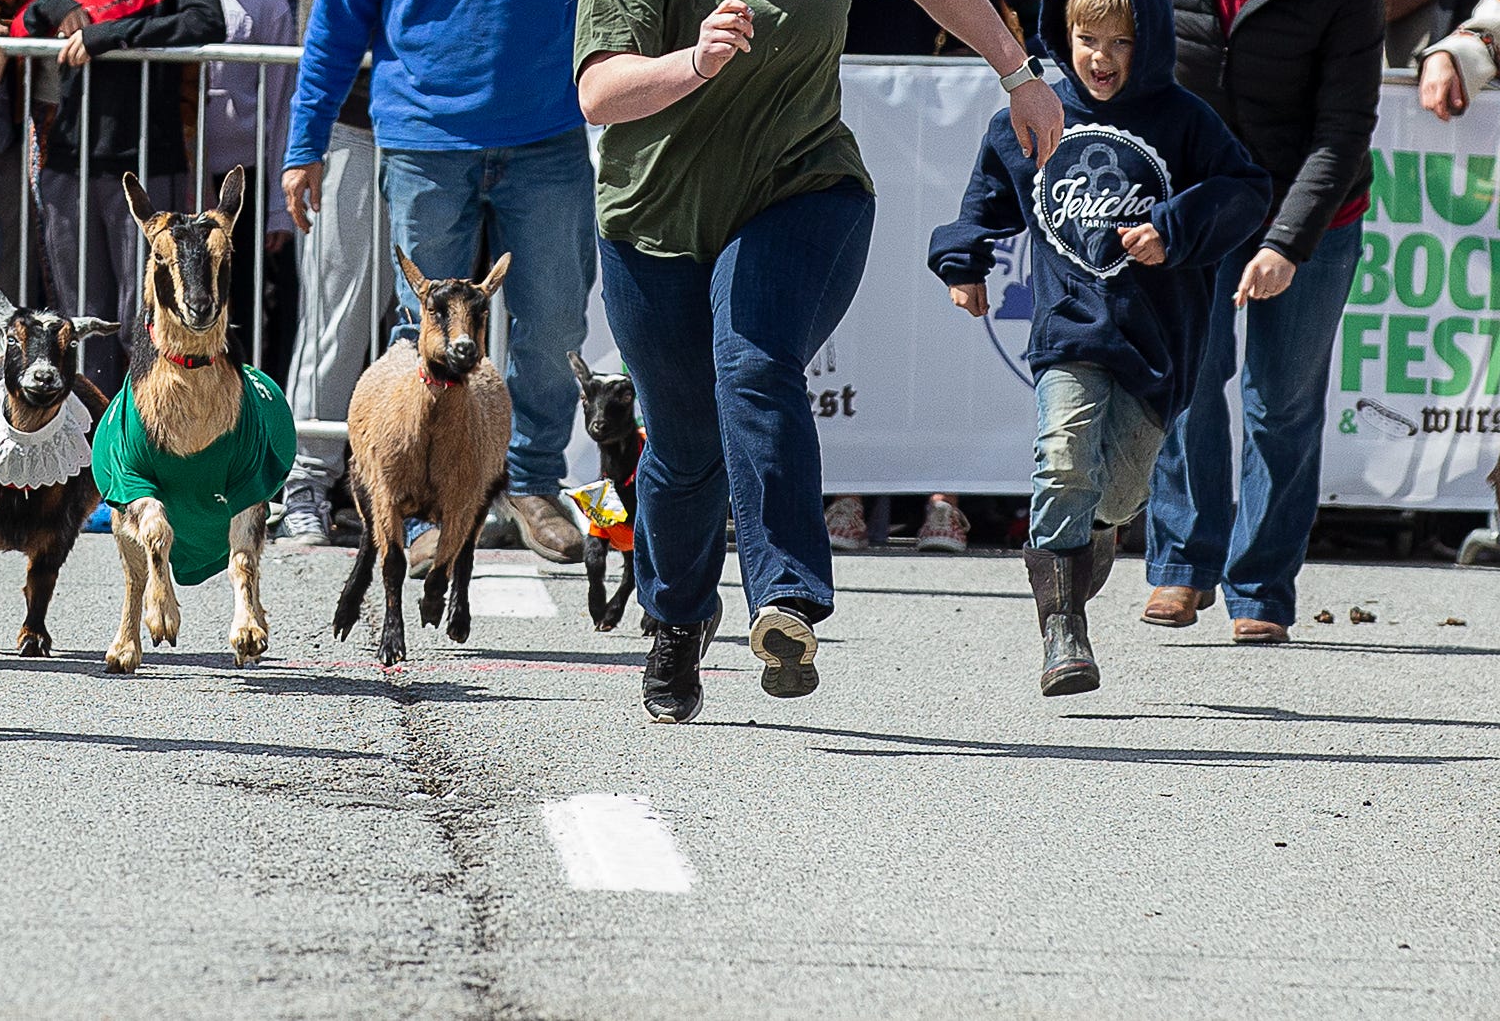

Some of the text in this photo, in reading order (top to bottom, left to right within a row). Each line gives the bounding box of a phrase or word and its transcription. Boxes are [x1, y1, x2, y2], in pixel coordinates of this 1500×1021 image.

[1051, 176, 1157, 229] Jericho
[1081, 218, 1143, 229] FARMHOUS
[1350, 230, 1500, 311] BOC
[807, 383, 857, 417] st
[1338, 407, 1358, 434] &
